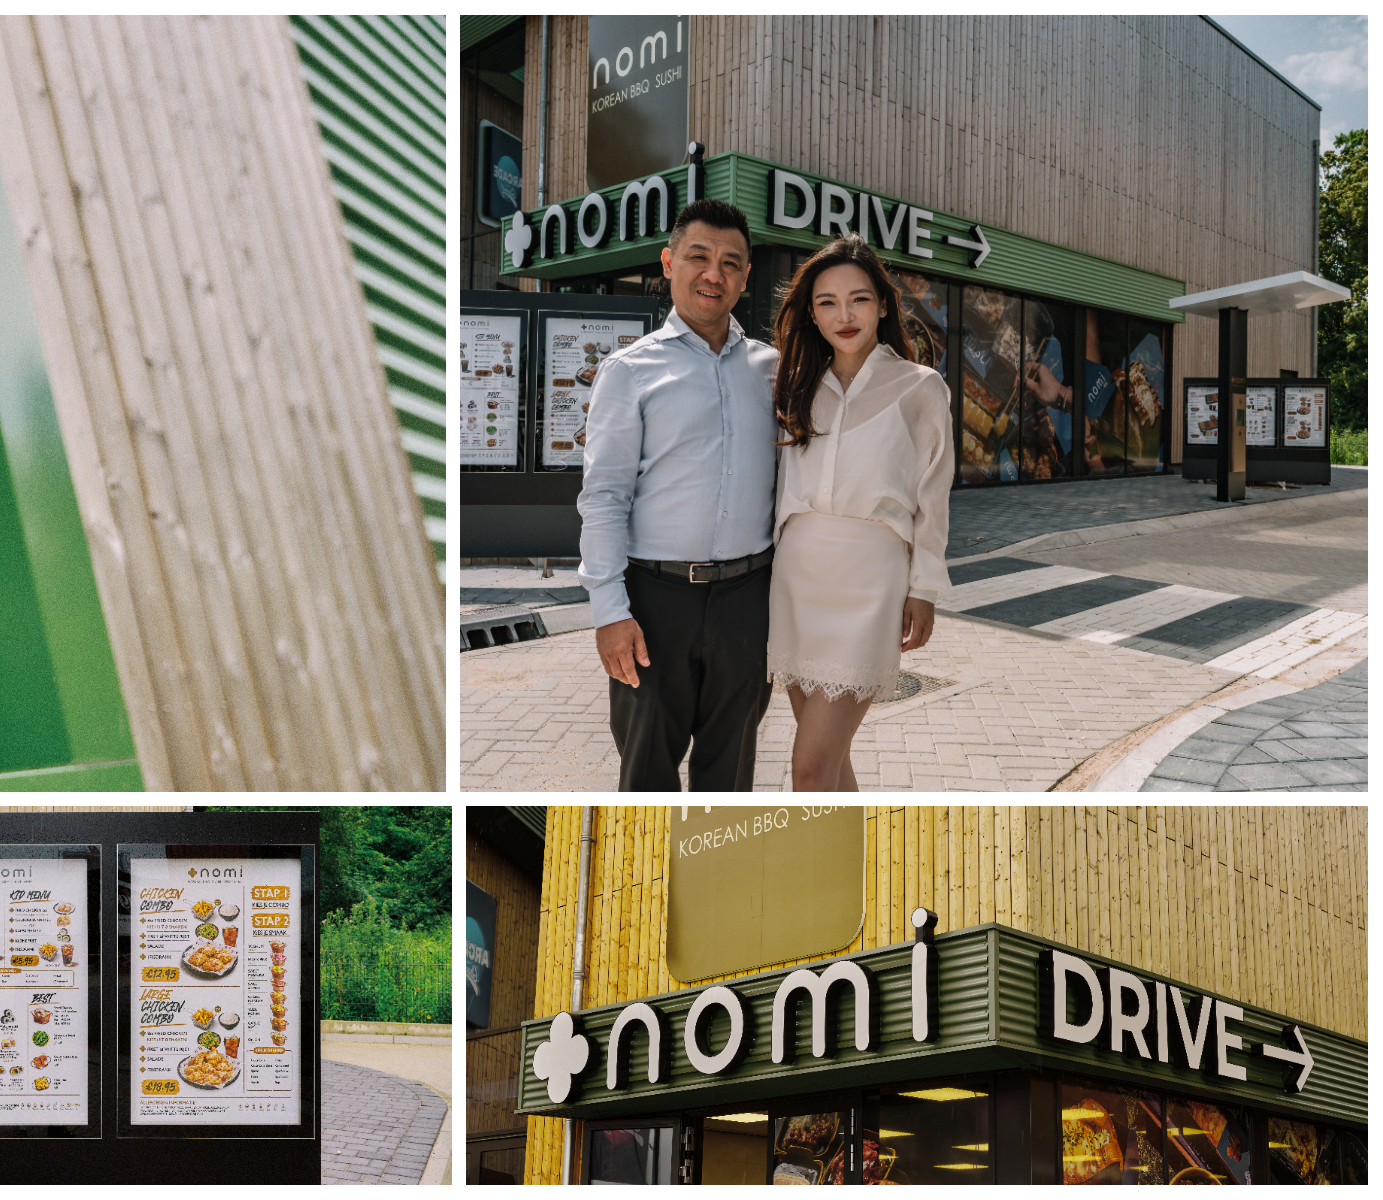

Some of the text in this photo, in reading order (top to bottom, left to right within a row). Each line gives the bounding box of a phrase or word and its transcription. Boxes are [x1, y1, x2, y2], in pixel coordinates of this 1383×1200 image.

[593, 15, 682, 89] nomi
[592, 66, 682, 113] KOREAN BBQ SUSHI
[540, 141, 700, 259] nomi
[768, 169, 934, 259] DRIVE
[1088, 372, 1106, 403] nomi
[679, 820, 748, 858] KOREAN
[753, 808, 789, 836] BBQ
[200, 865, 243, 878] nomi
[9, 890, 51, 900] KID MENU
[140, 887, 184, 900] CHICKEN
[254, 888, 288, 898] STAP 1
[140, 900, 174, 912] COMBO
[254, 916, 290, 926] STAP 2
[146, 969, 176, 980] €12.95
[31, 993, 56, 1003] BEST
[139, 988, 173, 1001] LARGE
[606, 907, 930, 1091] nomi
[141, 1000, 185, 1013] CHICKEN
[141, 1013, 174, 1024] COMBO
[1049, 950, 1247, 1081] DRIVE
[145, 1082, 176, 1092] €18.95
